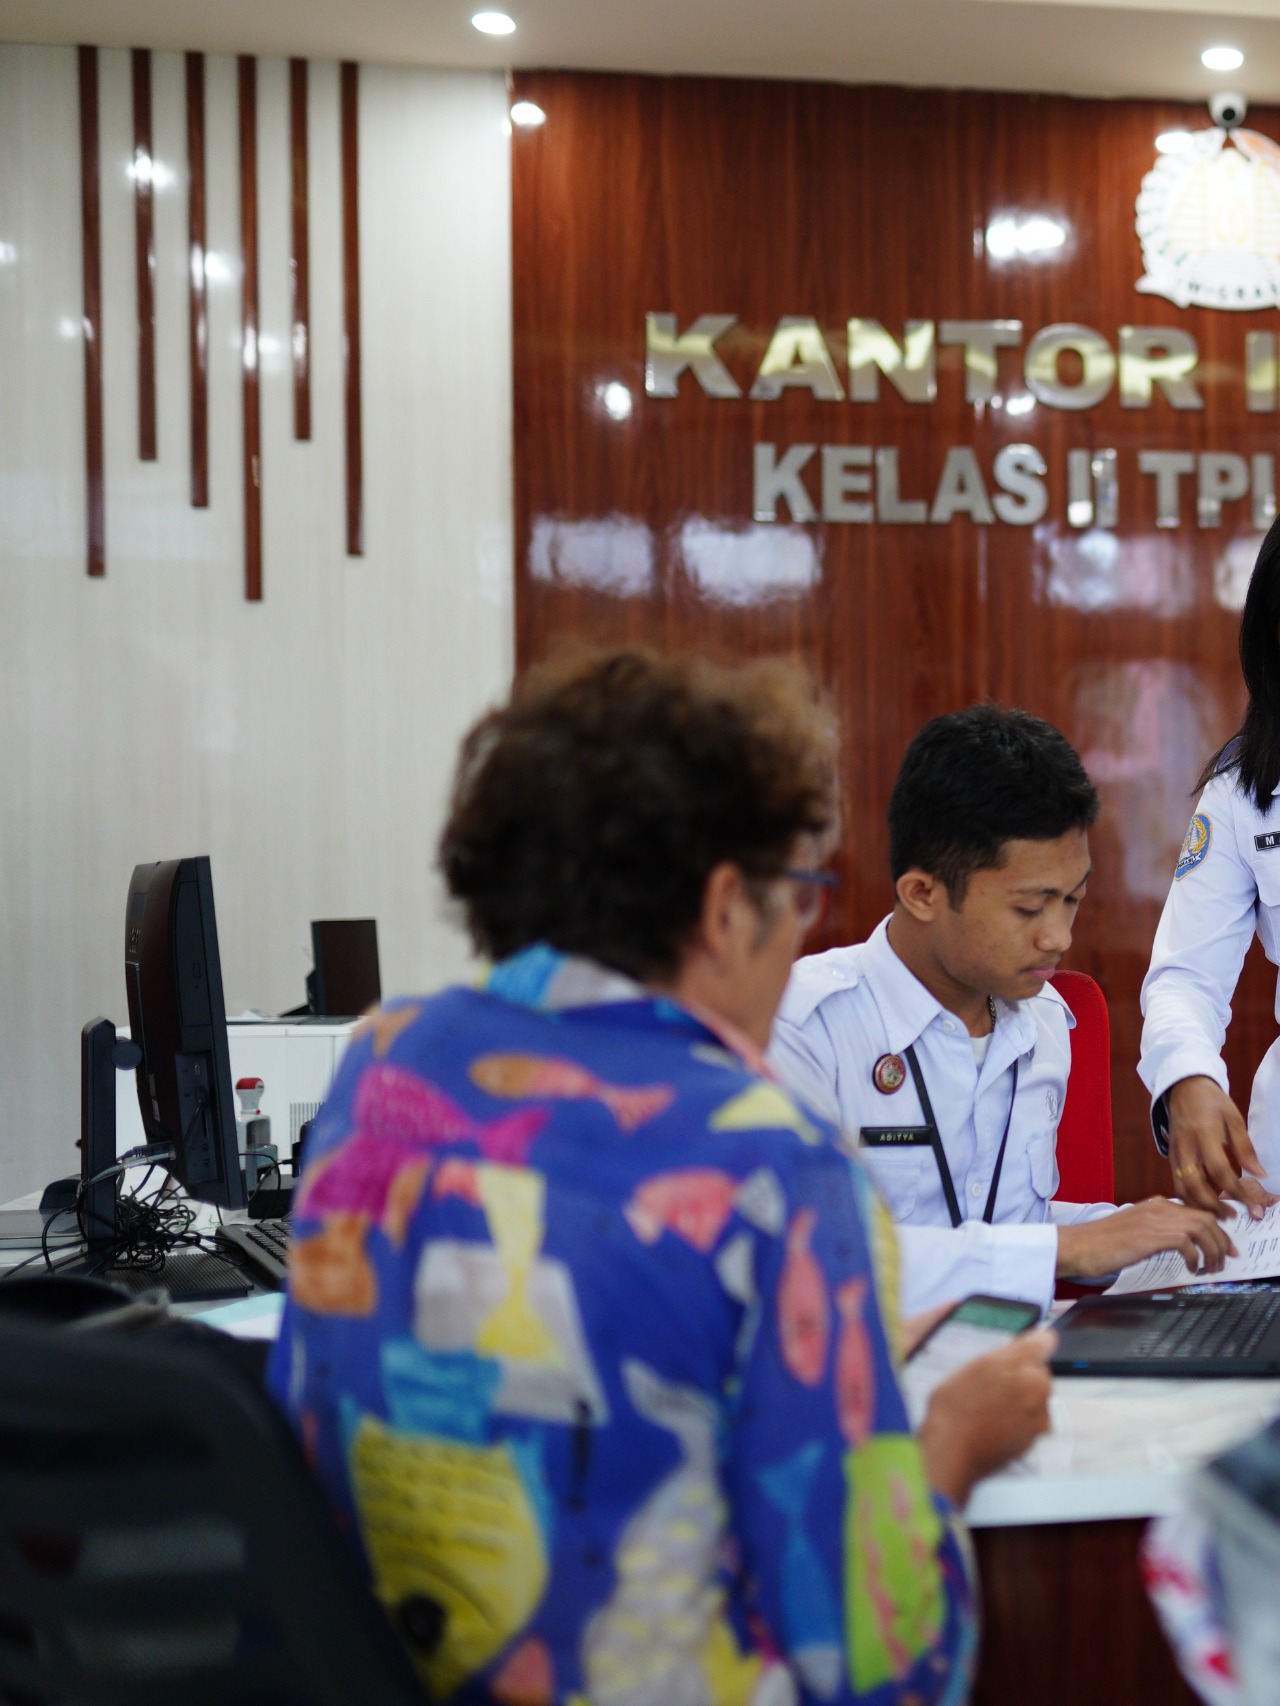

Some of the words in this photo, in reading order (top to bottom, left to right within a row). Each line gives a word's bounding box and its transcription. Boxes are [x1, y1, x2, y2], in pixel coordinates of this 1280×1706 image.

[645, 312, 1203, 410] KANTOR
[754, 442, 1048, 526] KELAS
[1067, 448, 1118, 528] II
[1139, 450, 1275, 530] TPI
[880, 1132, 914, 1142] ADITYA
